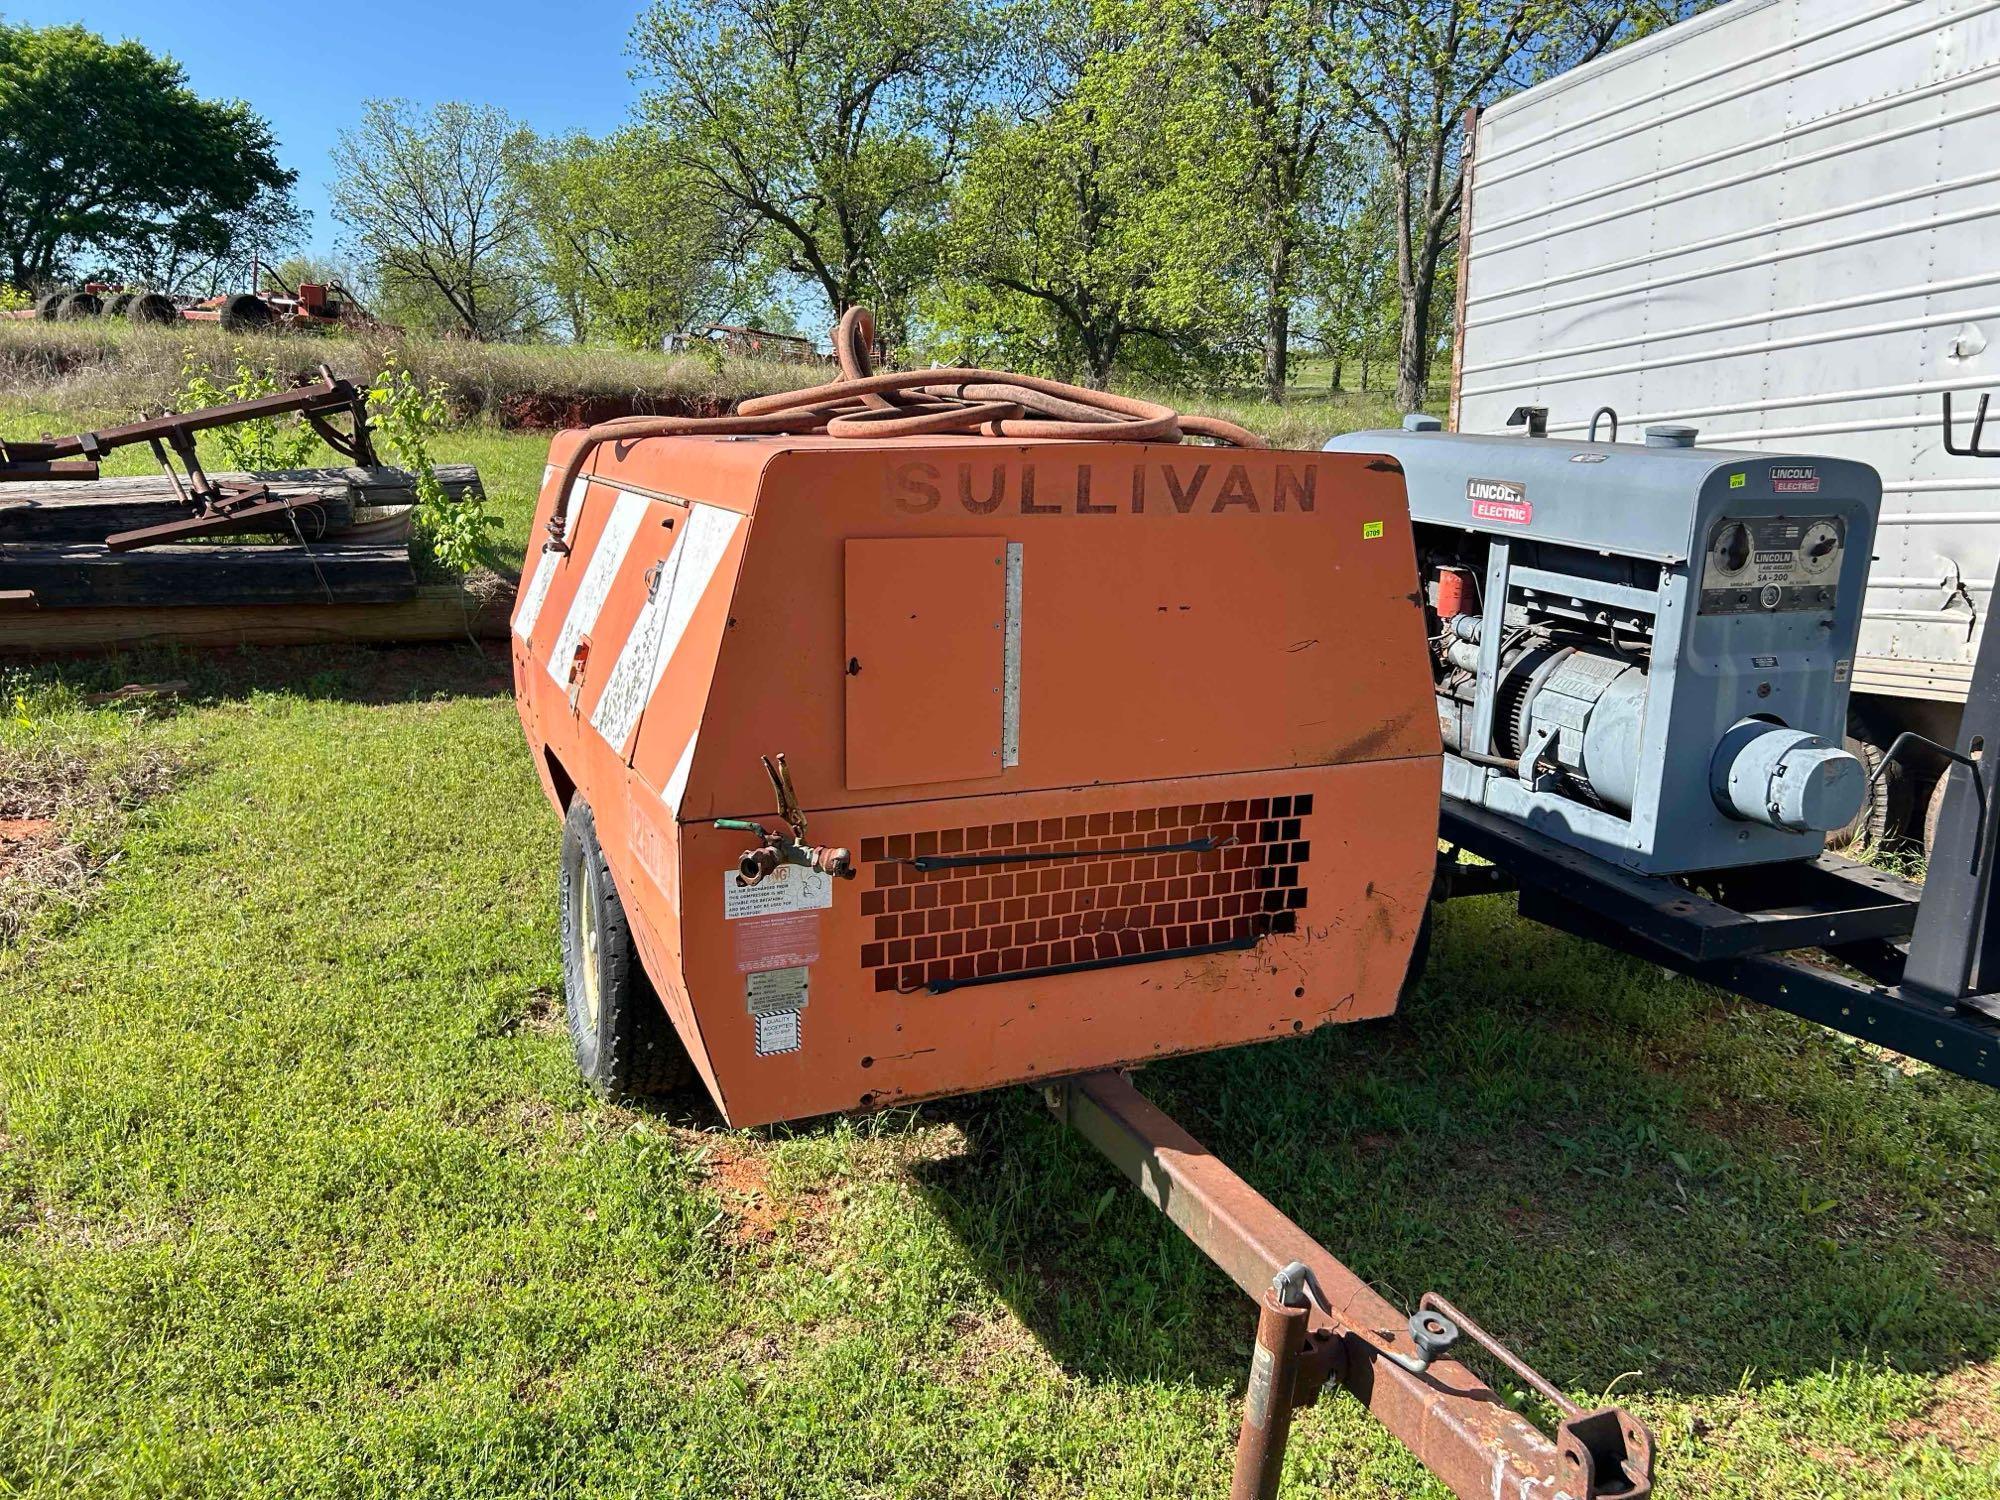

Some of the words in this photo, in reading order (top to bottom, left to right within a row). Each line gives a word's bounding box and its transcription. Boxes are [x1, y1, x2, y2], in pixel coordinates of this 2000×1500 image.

[1771, 469, 1812, 479] LINCOLN
[896, 462, 1318, 515] SULLIVAN
[1778, 482, 1815, 490] ELECTRIC
[1477, 504, 1527, 520] ELECTRIC
[1755, 553, 1791, 563] LINCOLN
[766, 1016, 790, 1025] QUALITY
[763, 1022, 794, 1033] ACCEPTED
